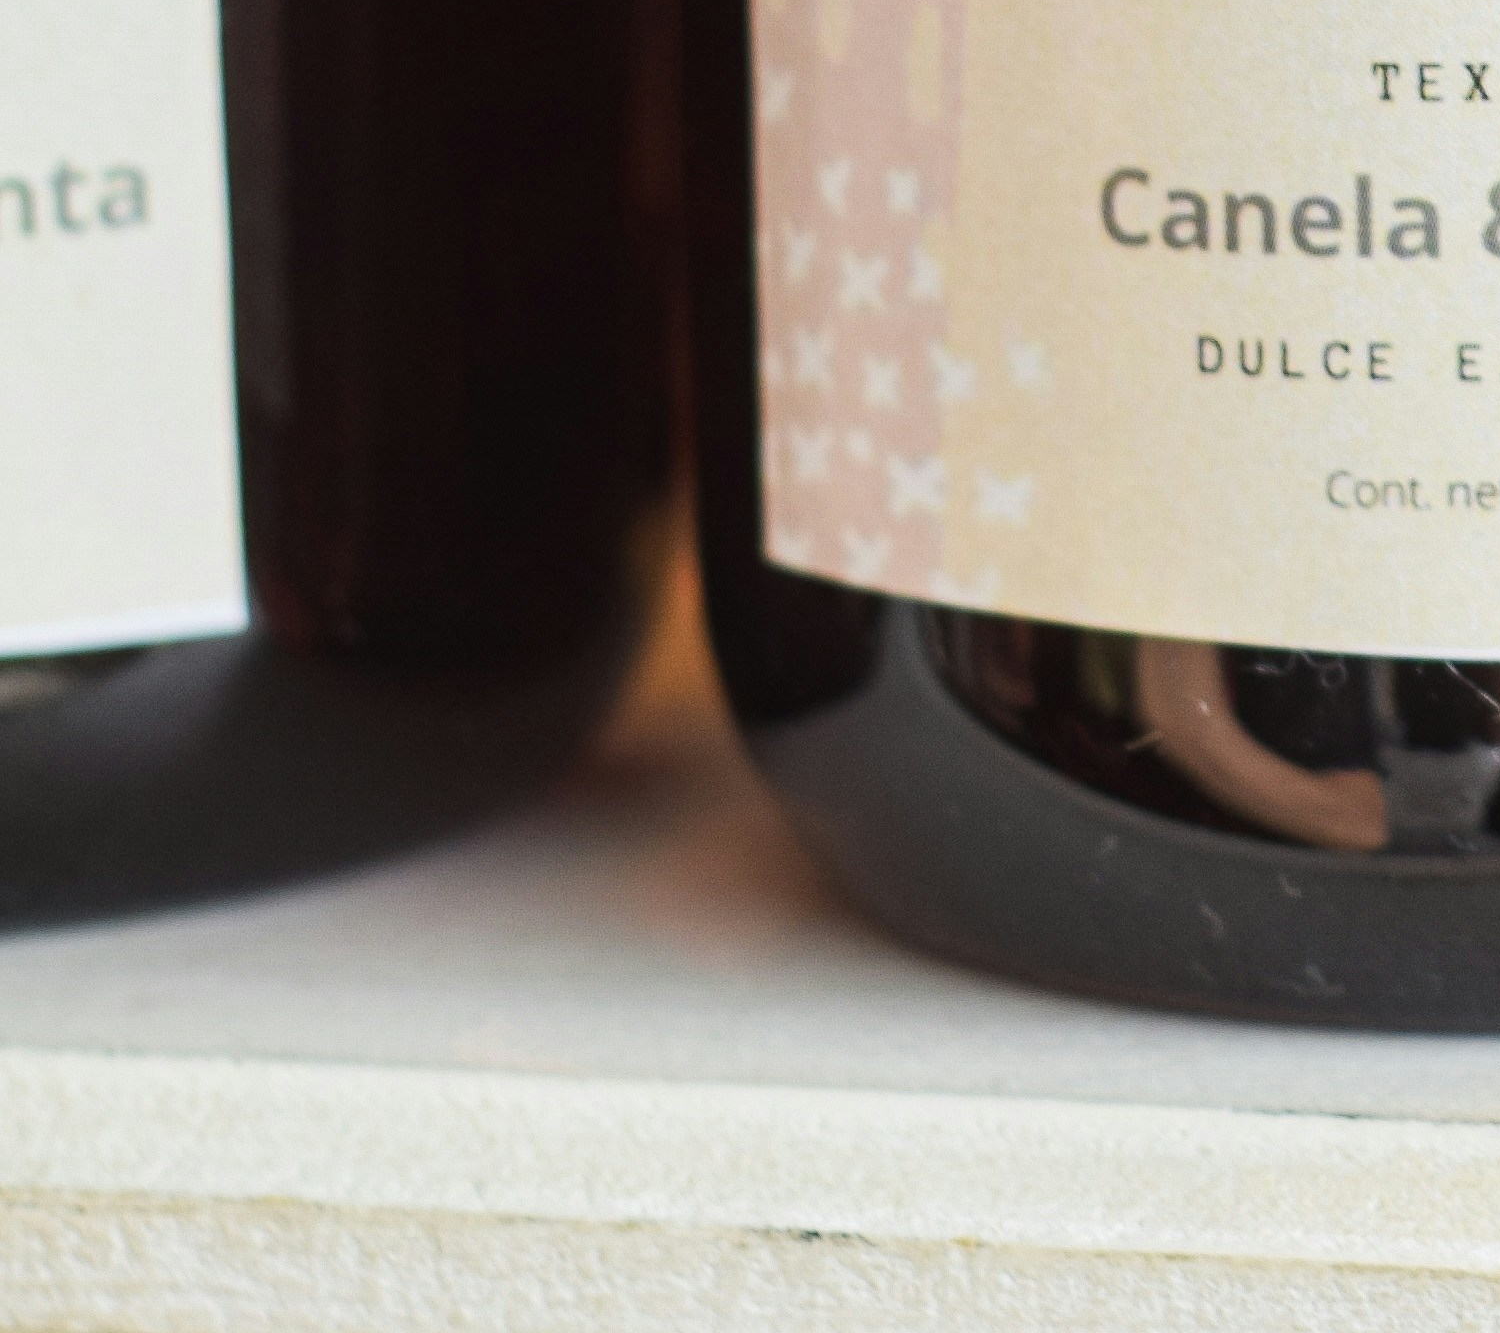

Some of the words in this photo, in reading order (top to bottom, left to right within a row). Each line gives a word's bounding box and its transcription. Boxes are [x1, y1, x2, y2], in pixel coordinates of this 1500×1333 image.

[1099, 166, 1441, 261] Canela
[1195, 333, 1393, 383] DULCE
[1323, 467, 1432, 512] Cont.
